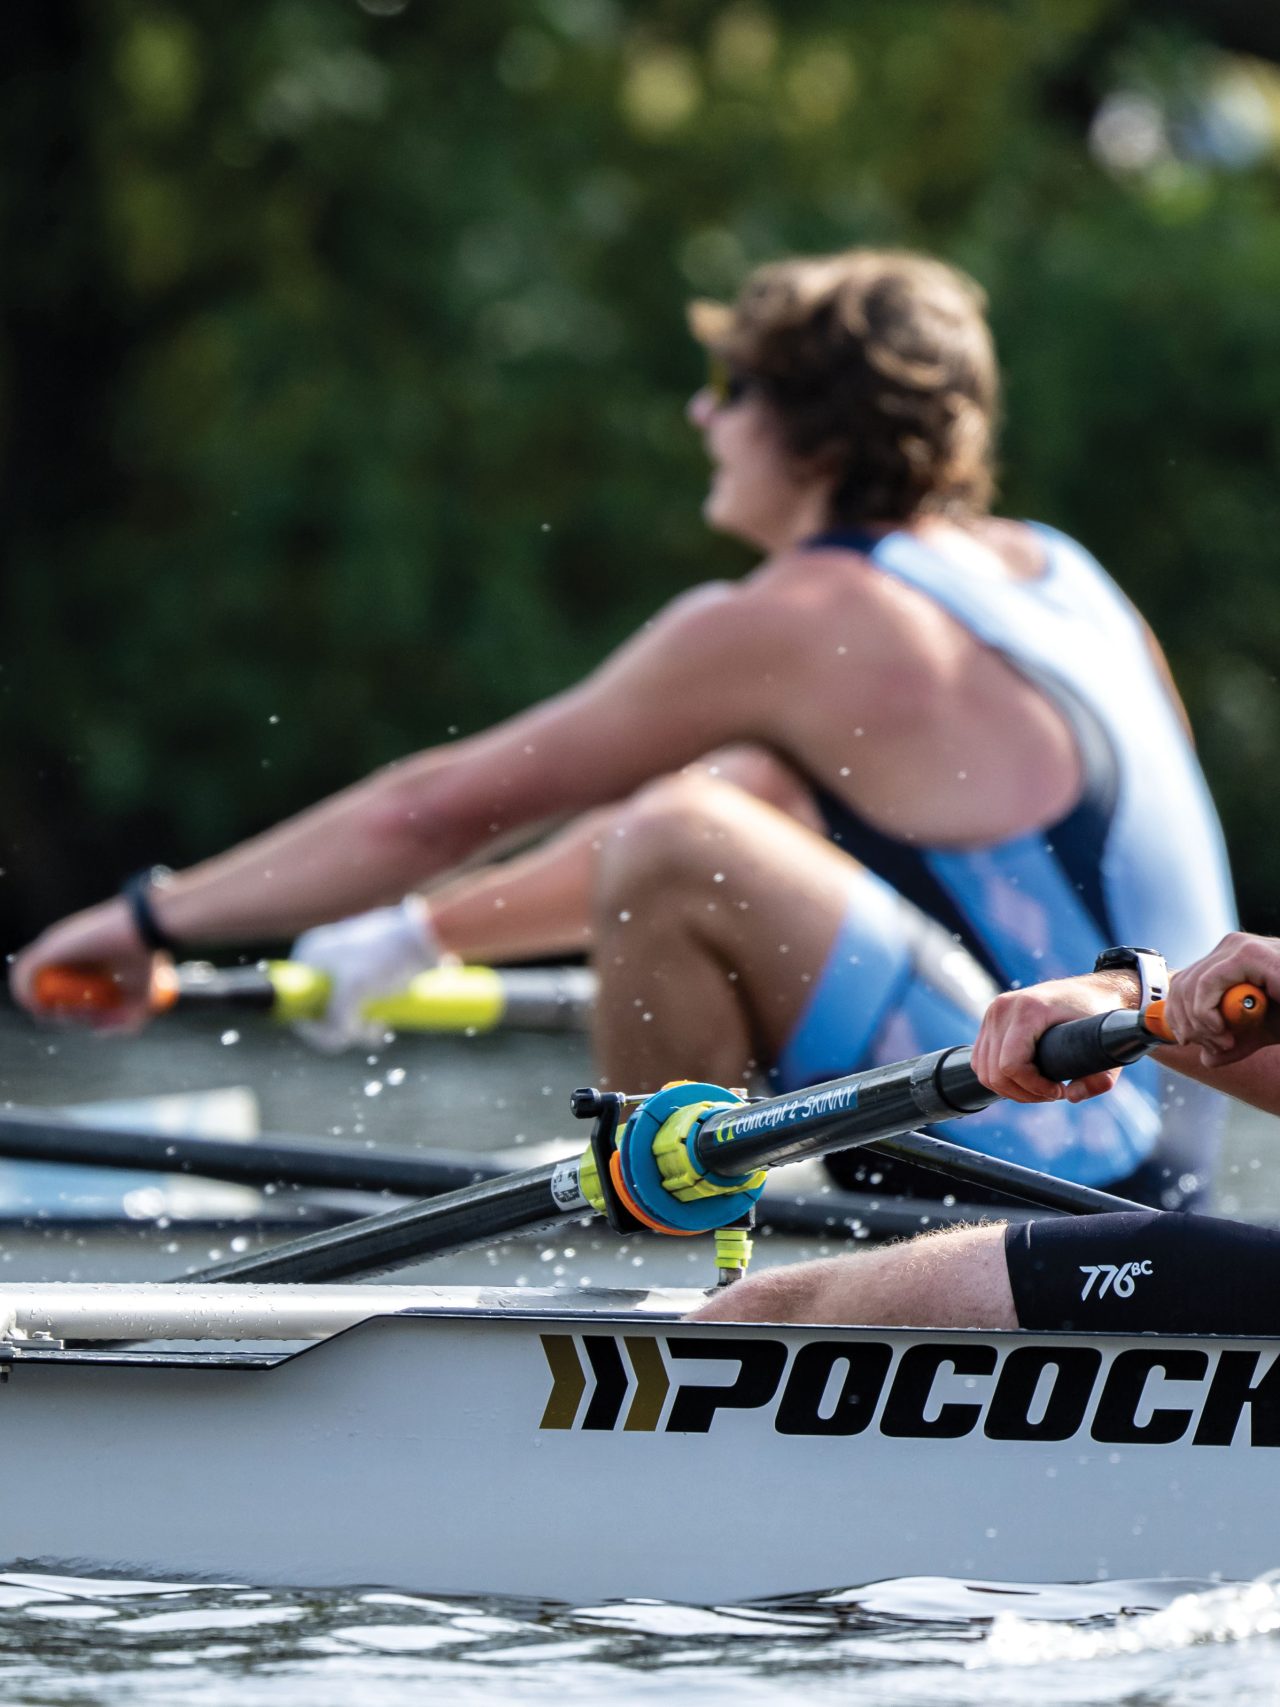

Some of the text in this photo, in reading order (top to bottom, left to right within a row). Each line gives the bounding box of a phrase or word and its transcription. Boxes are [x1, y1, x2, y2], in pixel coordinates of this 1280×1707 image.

[736, 1084, 858, 1134] concept 2 SKINNY
